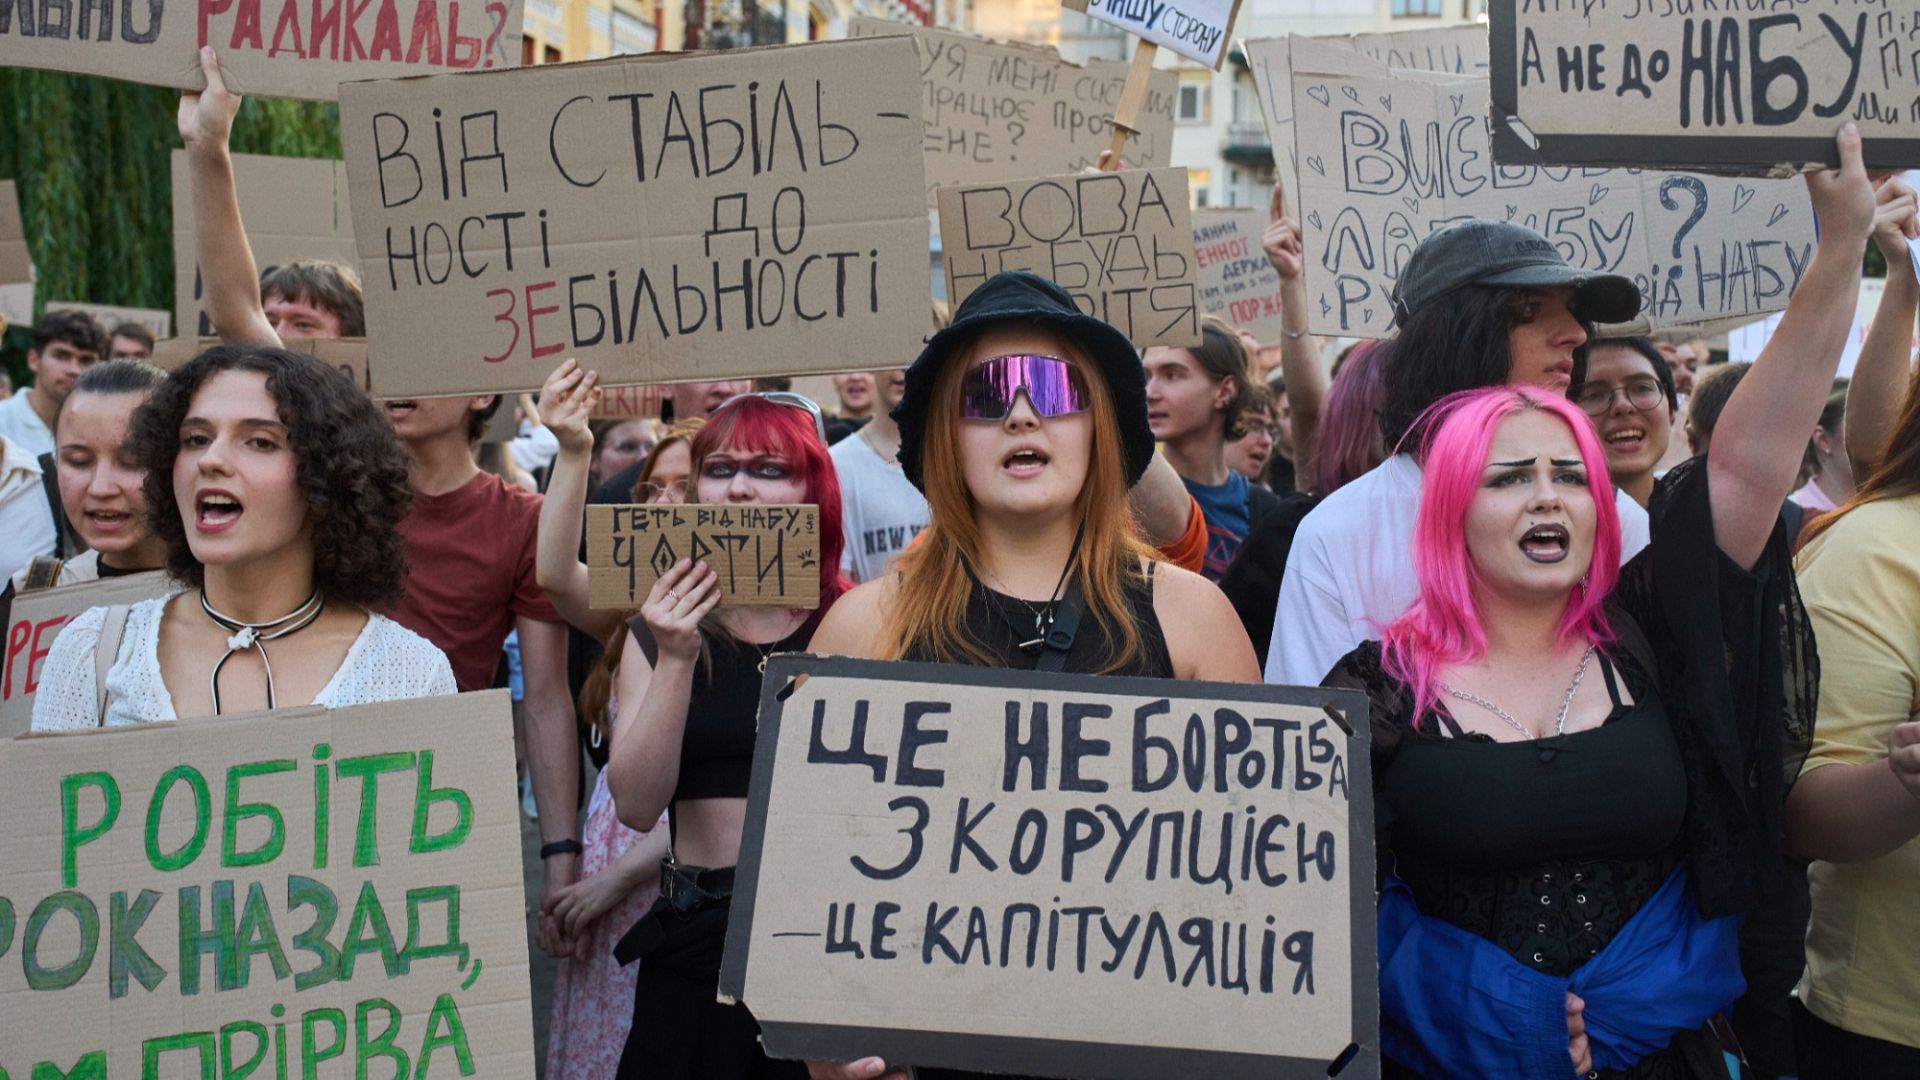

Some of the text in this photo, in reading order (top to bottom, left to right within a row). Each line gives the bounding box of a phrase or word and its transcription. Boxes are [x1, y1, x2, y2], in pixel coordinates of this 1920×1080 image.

[1162, 6, 1222, 54] СТОРОНУ
[988, 57, 1060, 95] МЕНІ
[1520, 27, 1545, 86] А
[1557, 44, 1606, 93] НЕ
[1616, 43, 1670, 98] ДО
[1680, 12, 1868, 128] НАБУ
[373, 107, 508, 208] ВІД
[386, 186, 805, 291] НОСТІ ДО
[959, 173, 1174, 250] ВОВА
[1050, 233, 1187, 289] БУДЬ
[1694, 239, 1811, 313] НАБУ
[612, 507, 686, 534] ГЕТЬ
[697, 507, 735, 529] ВІД
[740, 507, 801, 538] НАБУ,
[863, 526, 905, 555] NEW
[612, 528, 785, 603] ЧОРТИ
[807, 698, 1350, 801] ЦЕ НЕ БОРОТЬБА
[60, 743, 474, 889] РОБІТЬ
[850, 796, 1336, 895] З КОРУПЦІЄЮ
[922, 895, 1316, 996] КАПІТУЛЯЦІЯ
